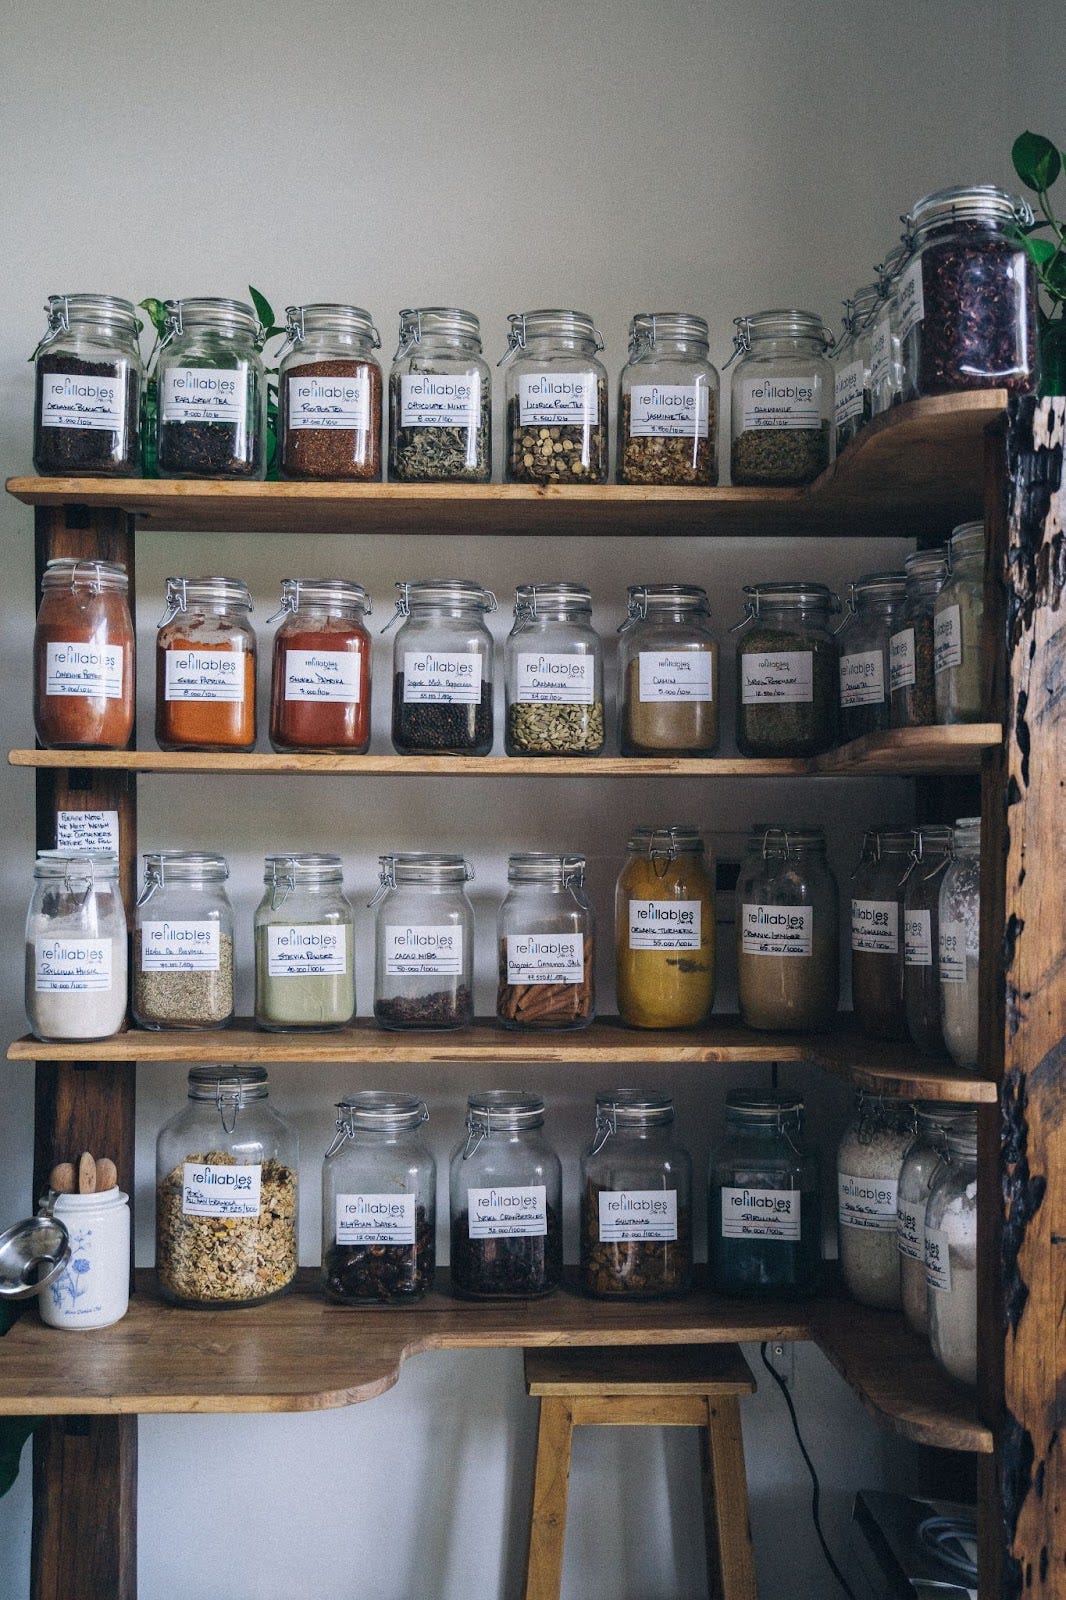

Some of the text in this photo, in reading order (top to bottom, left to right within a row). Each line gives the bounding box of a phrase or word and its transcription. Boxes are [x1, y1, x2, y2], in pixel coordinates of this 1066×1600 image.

[51, 377, 115, 399] refillables
[173, 371, 235, 391] refillables
[298, 380, 360, 399] refillables
[410, 377, 472, 397] refillables
[528, 376, 584, 395] refillable
[751, 380, 813, 398] refillables
[640, 388, 697, 407] refillable
[175, 652, 236, 671] refillables
[305, 657, 338, 668] refillables
[414, 654, 473, 673] refillables
[526, 656, 585, 674] refillables
[659, 658, 691, 668] refillables
[637, 902, 694, 922] refillables
[748, 907, 804, 926] refillables
[151, 923, 211, 941] refillables
[277, 928, 337, 946] refillables
[394, 928, 453, 946] refillables
[42, 942, 104, 960] refillables
[516, 937, 575, 955] refillables
[193, 1167, 252, 1186] refillables
[345, 1197, 405, 1214] refillables
[478, 1190, 538, 1208] refillables
[608, 1193, 668, 1211] refillables
[731, 1190, 791, 1210] refillables
